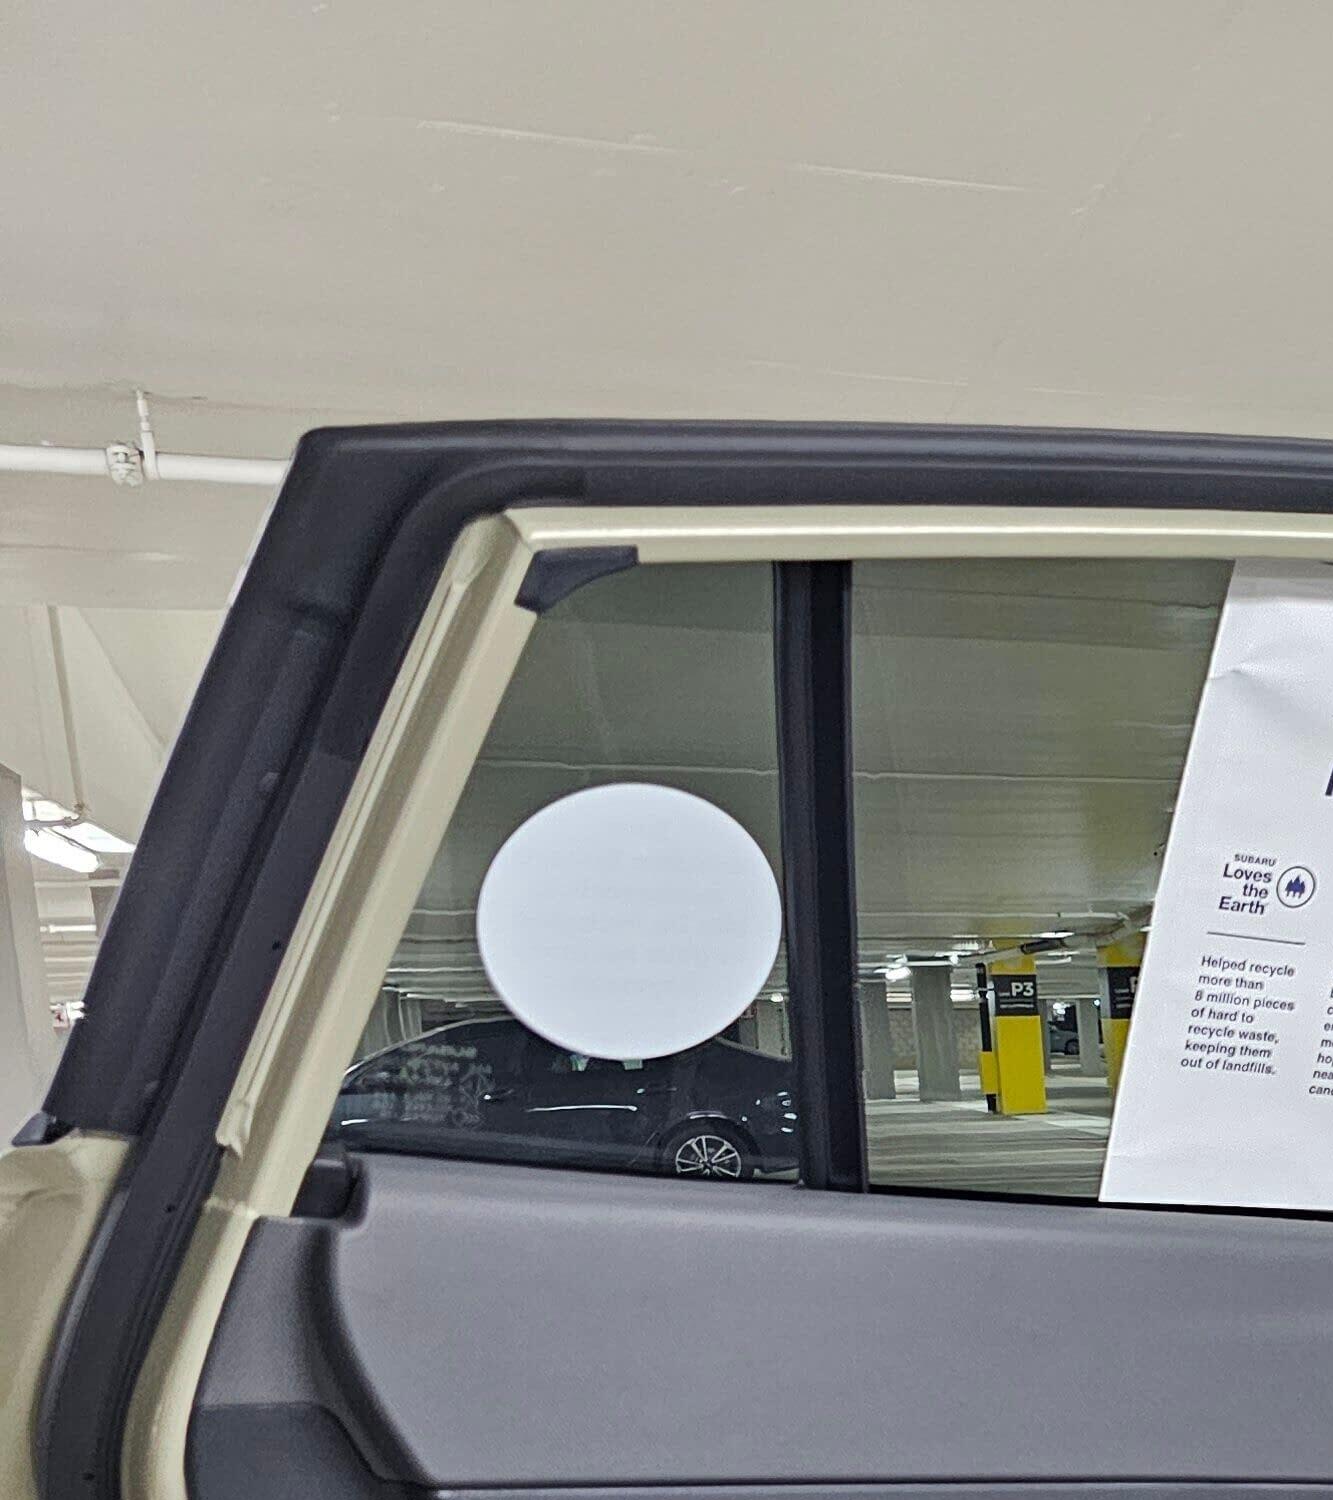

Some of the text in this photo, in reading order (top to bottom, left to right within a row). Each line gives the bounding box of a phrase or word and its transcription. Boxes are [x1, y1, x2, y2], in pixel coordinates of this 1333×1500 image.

[1233, 853, 1276, 867] SUBARU
[1222, 862, 1272, 883] Loves
[1242, 883, 1268, 898] the
[1218, 895, 1265, 915] Earth
[1200, 955, 1294, 977] Helped recycle
[1011, 982, 1034, 997] P3
[1198, 975, 1264, 990] more than
[1194, 989, 1295, 1011] 8 million pieces
[1190, 1006, 1254, 1023] of hard to
[1187, 1024, 1279, 1044] recycle waste,
[1184, 1039, 1272, 1058] keeping them
[1180, 1057, 1275, 1075] out of landfills.
